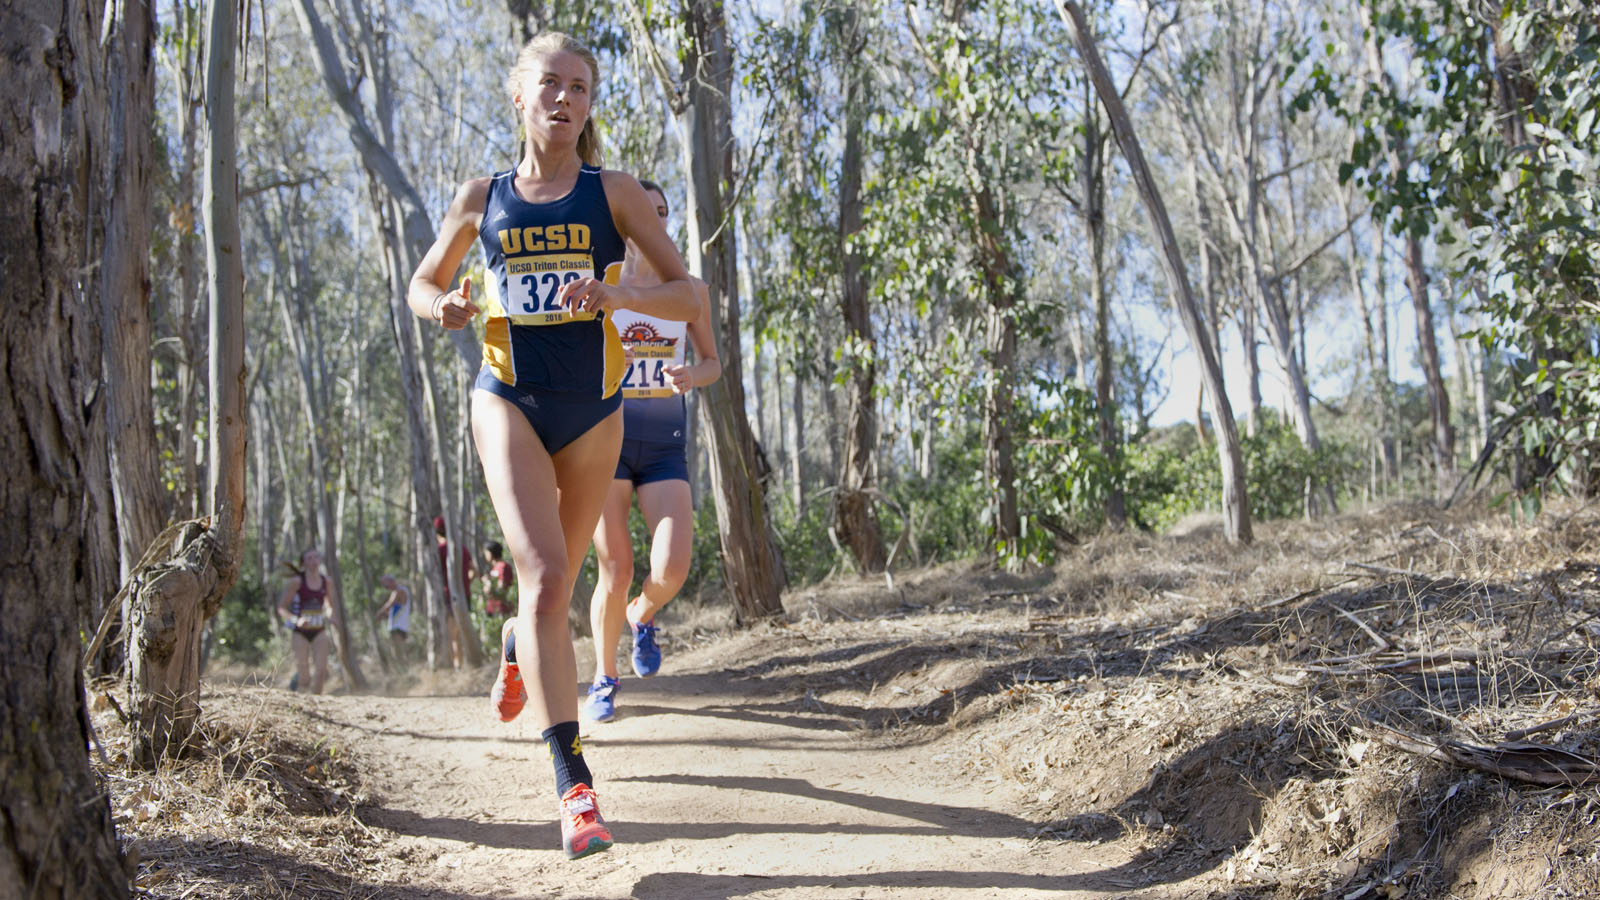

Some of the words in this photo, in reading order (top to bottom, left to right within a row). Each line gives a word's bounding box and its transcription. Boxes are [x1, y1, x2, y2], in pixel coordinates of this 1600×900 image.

[498, 224, 590, 254] UCSD
[510, 262, 531, 273] UCSD
[533, 261, 557, 271] Triton
[560, 260, 590, 269] Classic
[621, 360, 664, 387] 214
